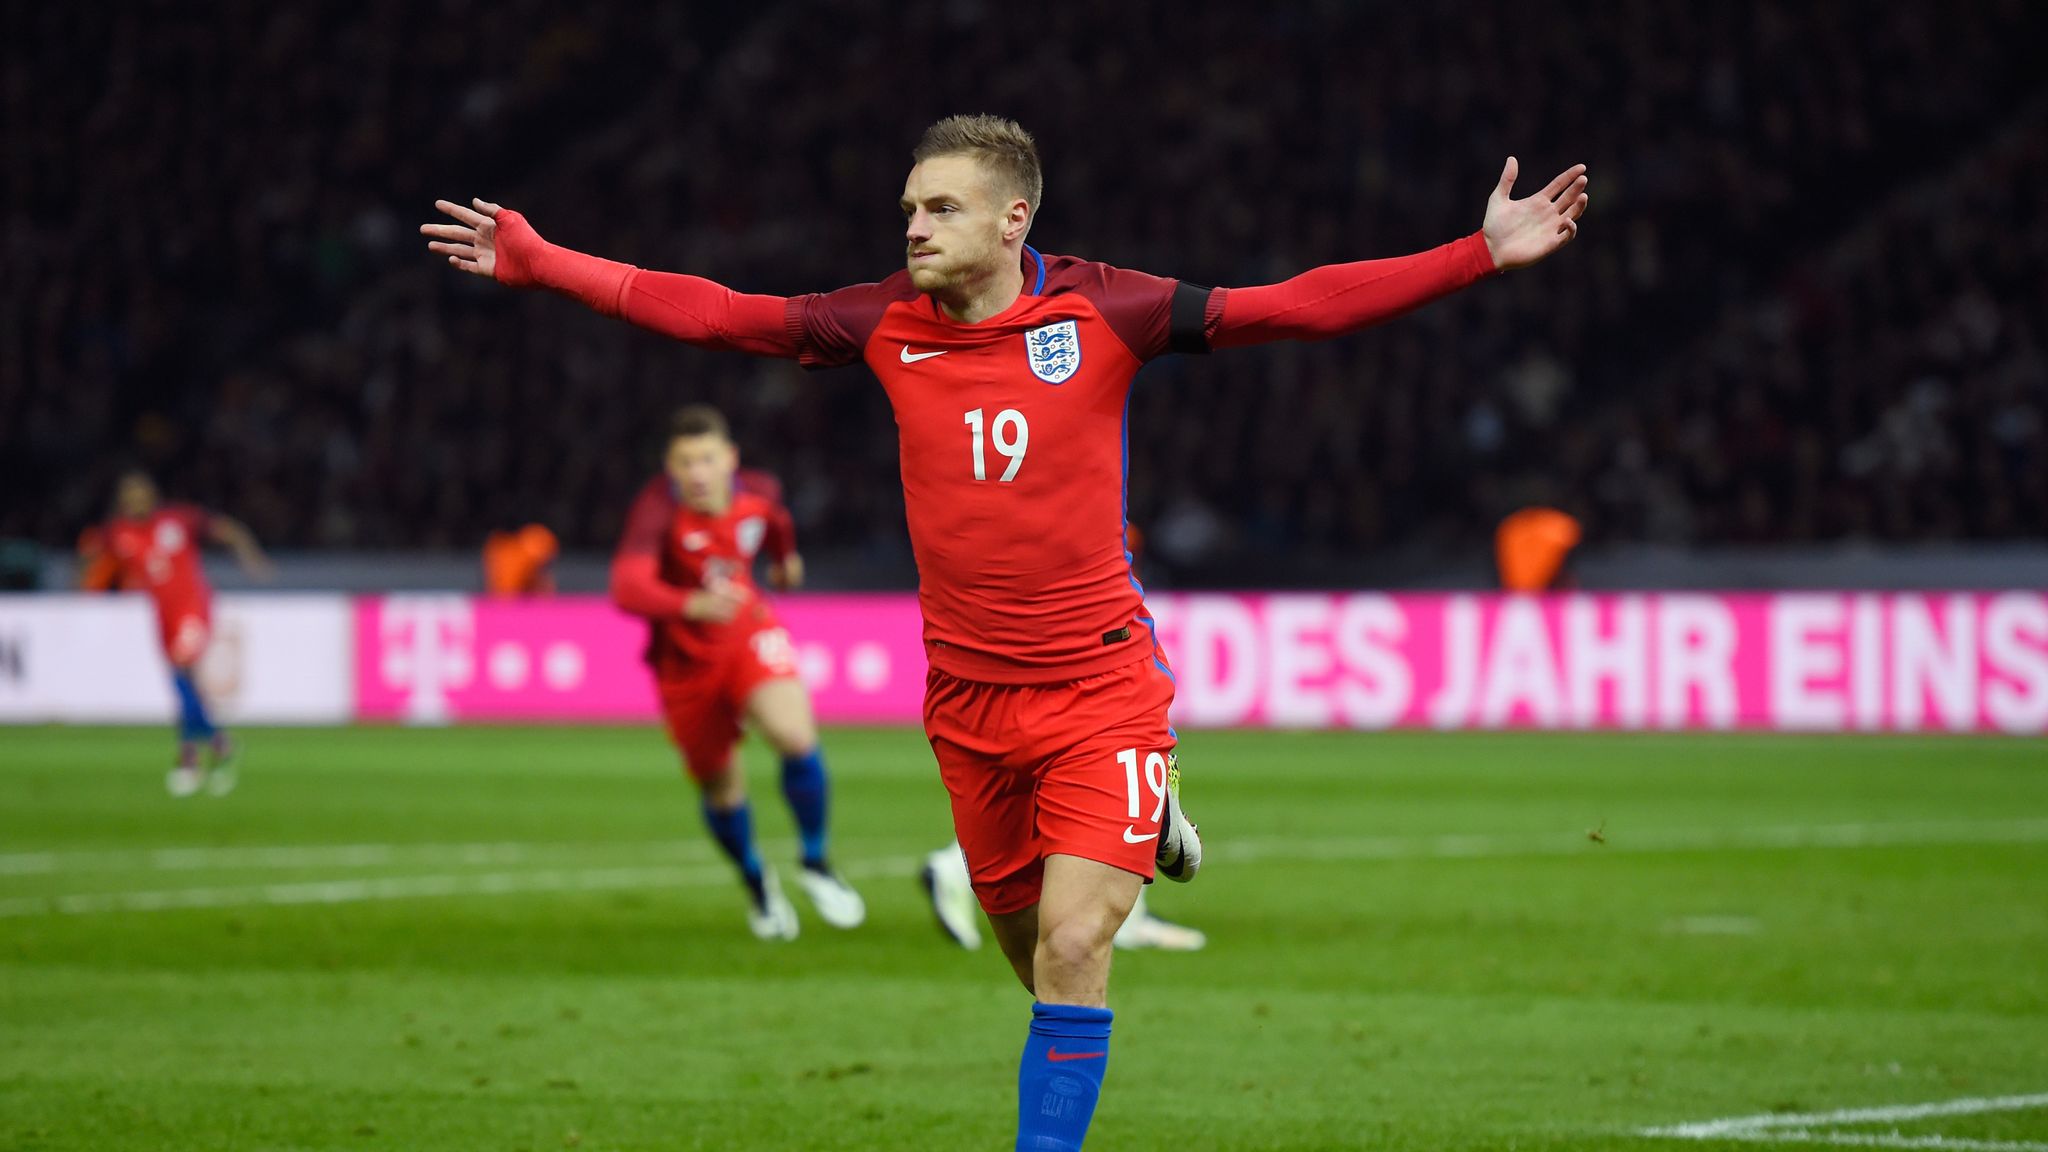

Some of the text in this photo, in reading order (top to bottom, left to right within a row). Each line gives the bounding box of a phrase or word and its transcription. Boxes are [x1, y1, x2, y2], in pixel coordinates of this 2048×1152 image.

[964, 408, 1029, 482] 19
[1430, 592, 1736, 730] JAHR
[1771, 592, 2048, 733] EINS
[1116, 748, 1167, 823] 19
